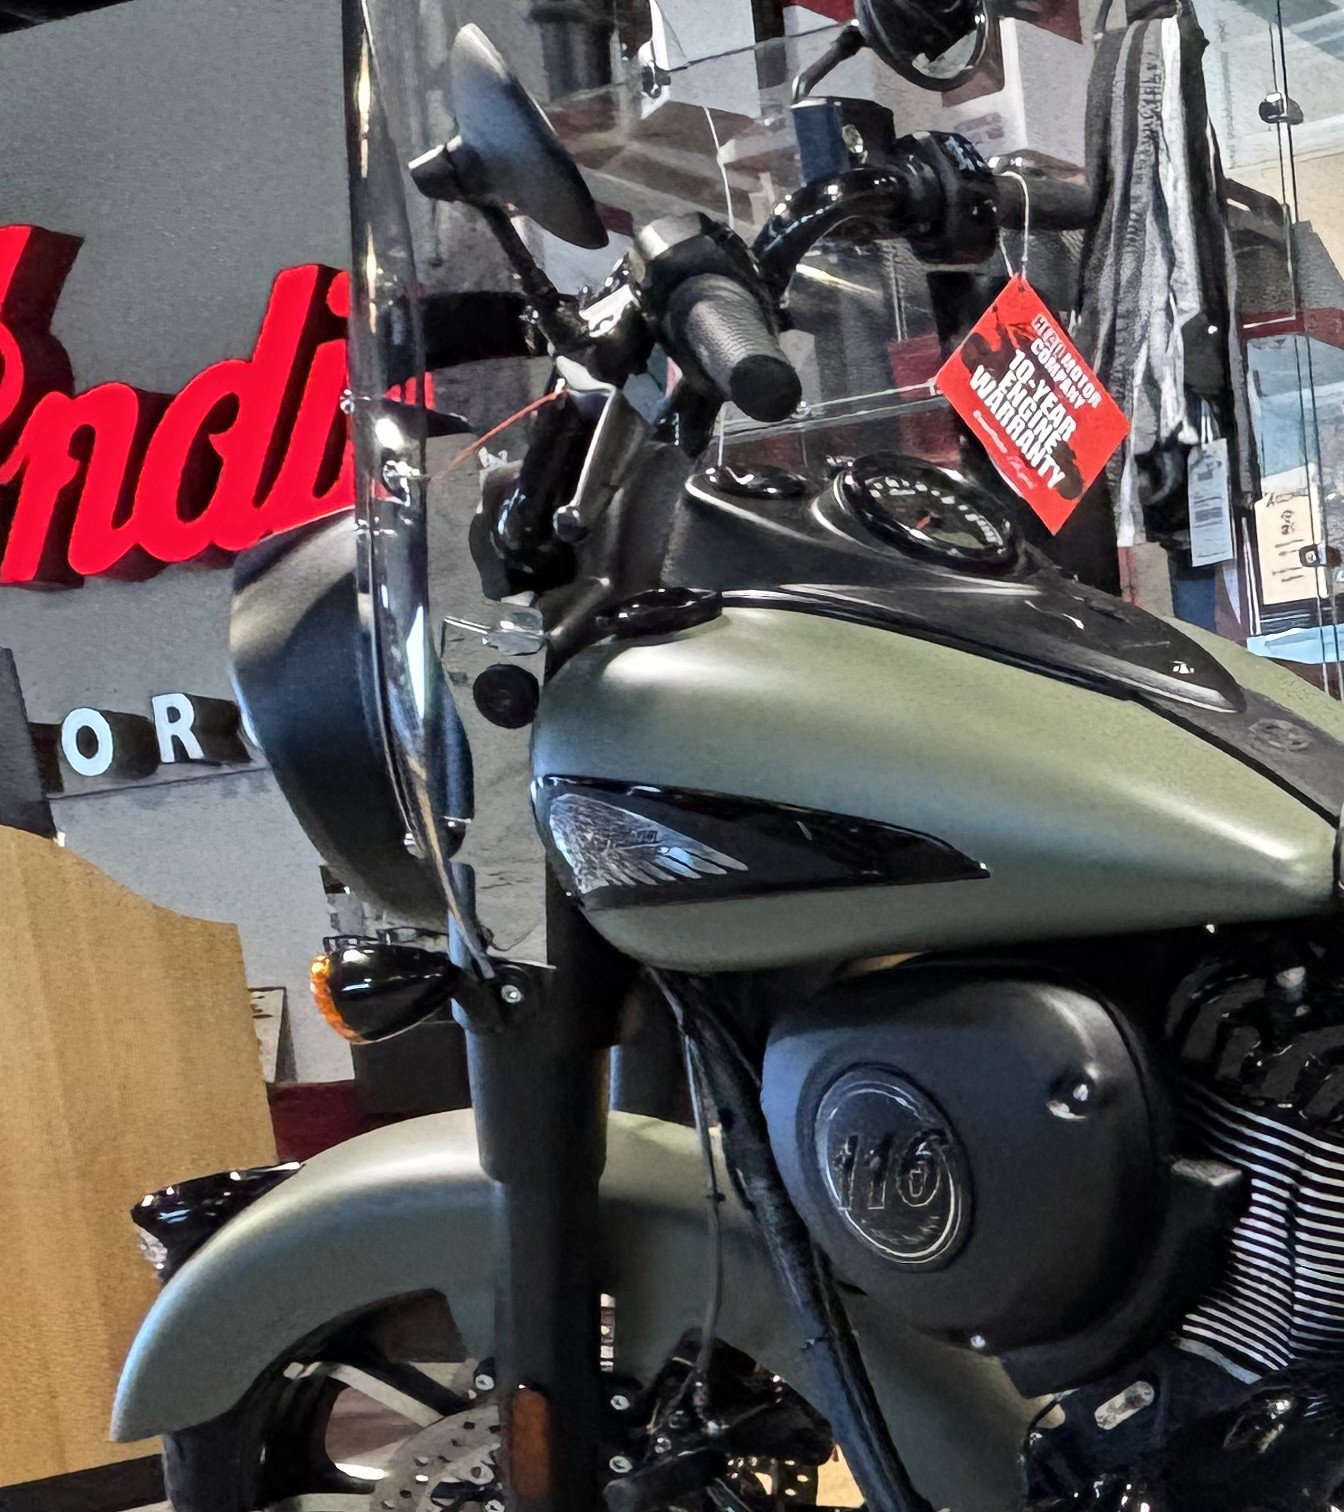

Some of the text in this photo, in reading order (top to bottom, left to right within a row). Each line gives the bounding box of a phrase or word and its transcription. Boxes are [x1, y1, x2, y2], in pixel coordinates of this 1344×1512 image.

[997, 369, 1062, 455] ENGINE
[1009, 349, 1077, 441] 10-YEAR
[1030, 338, 1086, 410] COMPANY
[969, 364, 1067, 489] WARRANTY
